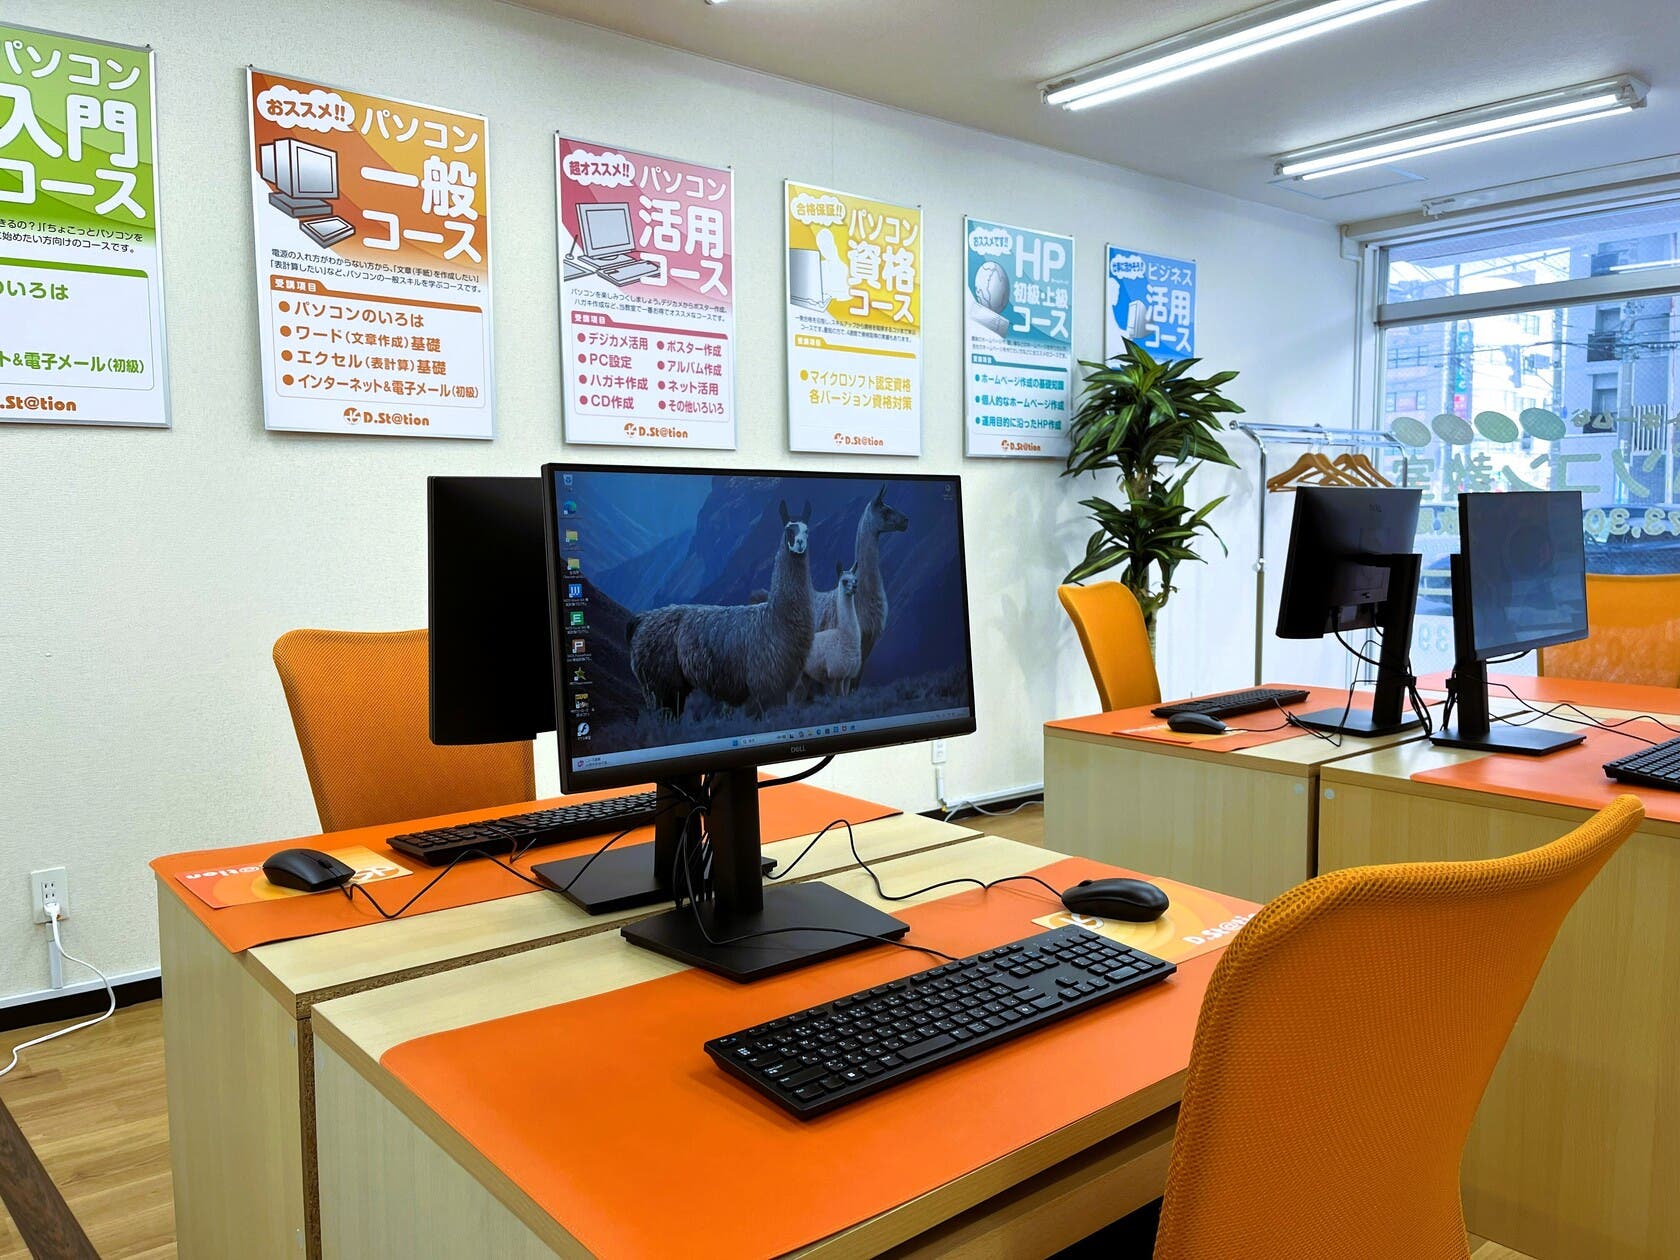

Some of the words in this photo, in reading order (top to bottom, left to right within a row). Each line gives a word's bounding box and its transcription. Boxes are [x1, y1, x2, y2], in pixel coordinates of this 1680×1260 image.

[2, 40, 141, 90] パソコン
[266, 98, 346, 122] おススメ!!
[0, 83, 139, 169] 入門
[360, 108, 479, 153] パソコン
[569, 161, 630, 178] 超オススメ!!
[0, 158, 147, 219] コース
[360, 155, 479, 221] 一般
[640, 166, 726, 201] パソコン
[362, 209, 482, 264] コース
[639, 195, 724, 259] 活用
[849, 209, 918, 247] パソコン
[848, 239, 916, 293] 資格
[1015, 235, 1066, 282] HP
[274, 278, 317, 292] 受講項目
[640, 252, 728, 296] コース
[1148, 262, 1193, 287] ビジネス
[294, 301, 425, 328] パソコンのいろは
[849, 288, 914, 323] コース
[1146, 284, 1191, 326] 活用
[1013, 305, 1069, 338] コース
[296, 325, 441, 353] ワード（文章作成）基礎
[588, 332, 649, 351] デジカメ活用
[667, 340, 722, 357] ポスター作成
[1145, 323, 1192, 353] コース
[297, 350, 447, 376] エクセル（表計算）基礎
[589, 352, 633, 370] PC設定
[667, 360, 722, 377] アルバム作成
[298, 374, 479, 399] インターネット&電子メール（初級）
[590, 374, 649, 391] ハガキ作成
[668, 380, 719, 396] ネット活用
[809, 370, 911, 393] マイクロソフト認定資格
[591, 394, 635, 410] CD作成
[668, 400, 725, 415] その他いろいろ
[809, 389, 913, 411] 各バージョン資格対策
[363, 410, 430, 427] D.St@tion
[638, 426, 689, 439] D.St@tion
